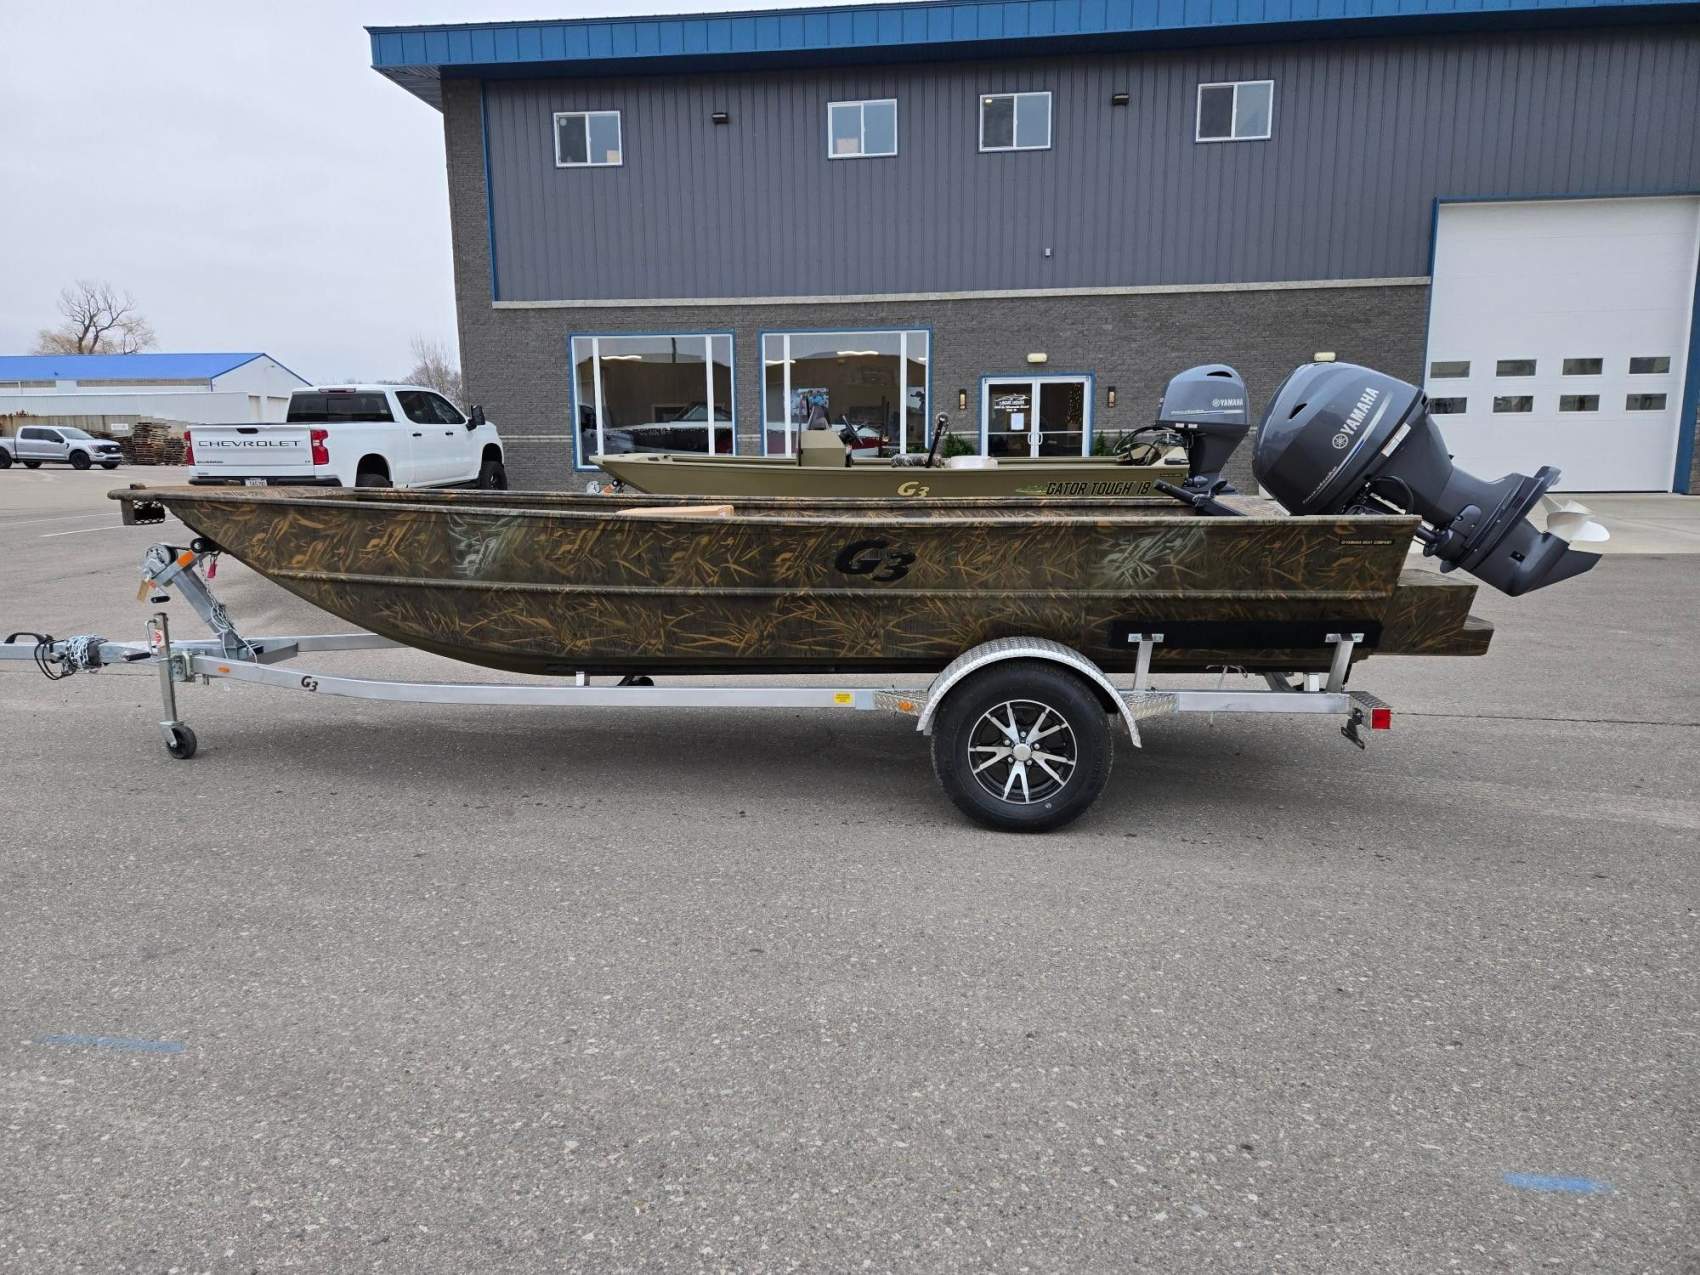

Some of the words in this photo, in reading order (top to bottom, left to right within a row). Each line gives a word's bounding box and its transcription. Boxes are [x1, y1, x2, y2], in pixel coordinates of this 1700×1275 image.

[1220, 398, 1244, 407] YAMAHA
[1340, 387, 1380, 435] YAMAHA
[897, 481, 930, 498] G3
[1046, 481, 1087, 495] GATOR
[1091, 481, 1134, 495] TOUGH
[1136, 481, 1151, 495] 18
[835, 539, 917, 582] G3
[301, 675, 318, 692] G3
